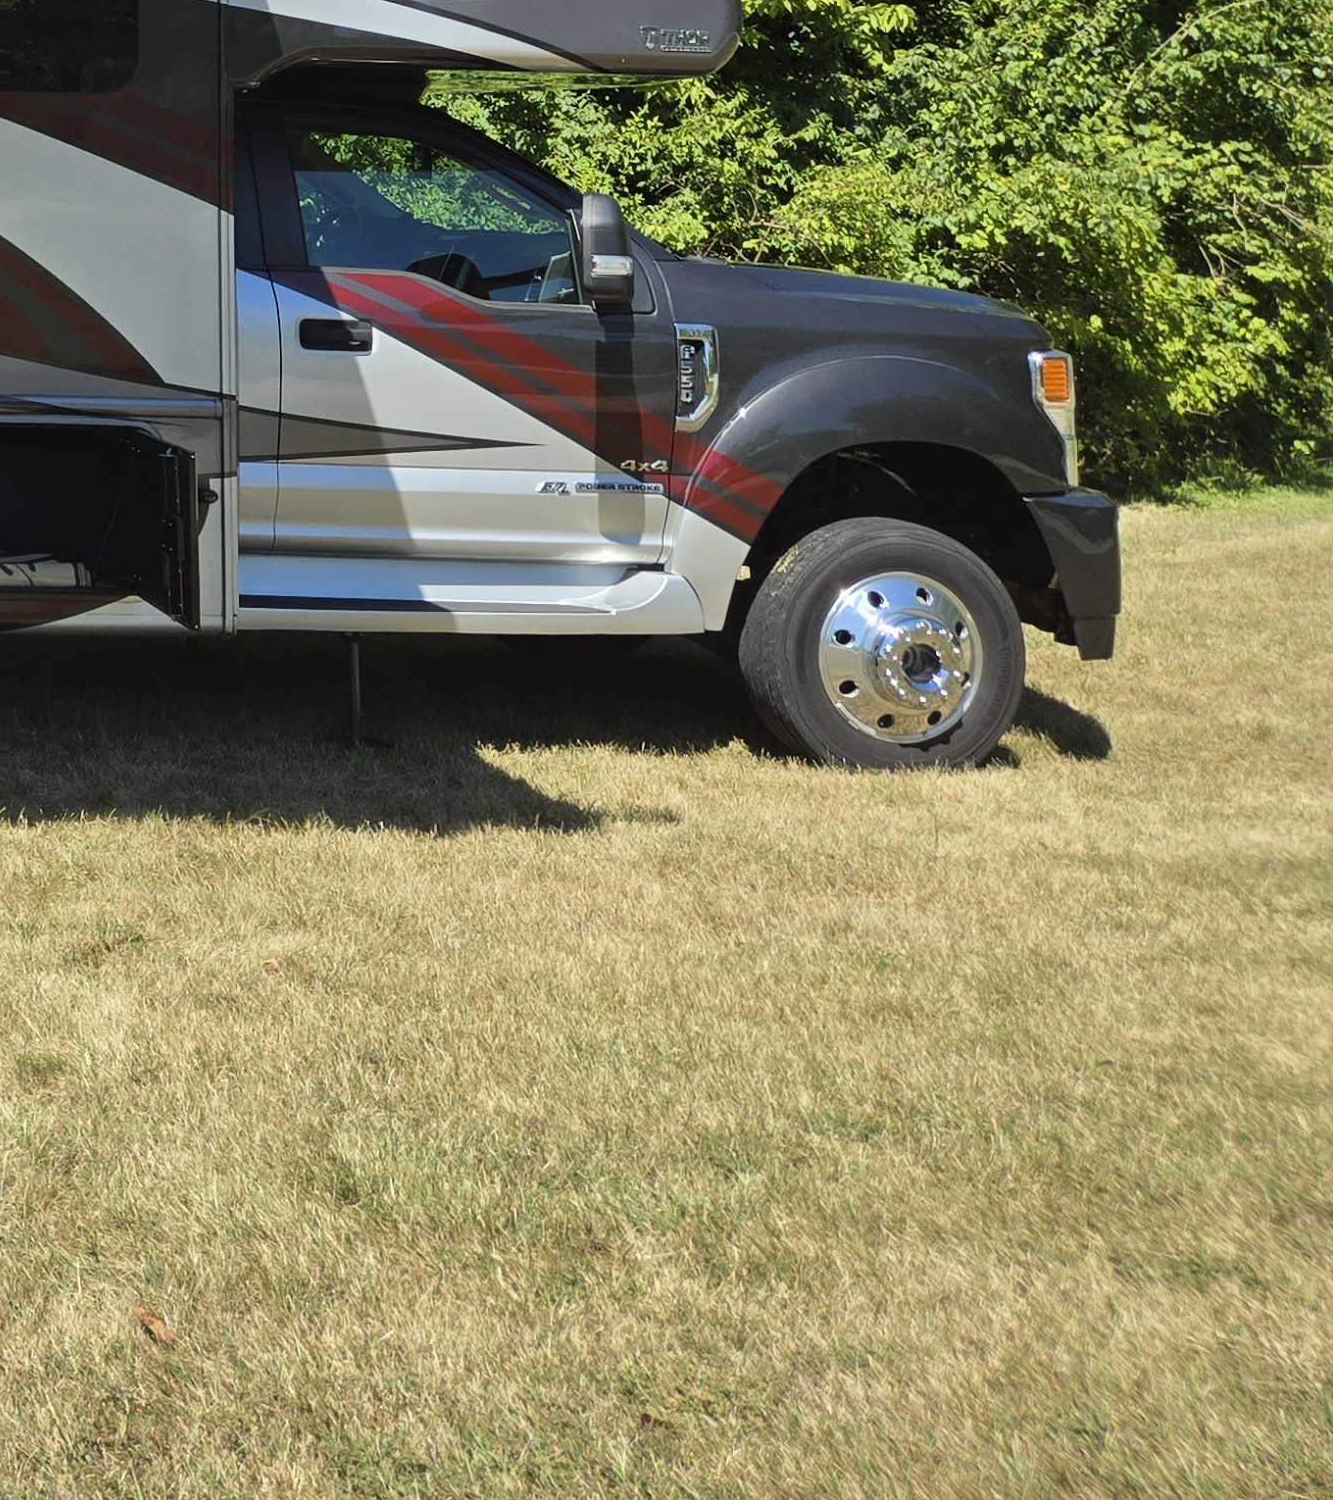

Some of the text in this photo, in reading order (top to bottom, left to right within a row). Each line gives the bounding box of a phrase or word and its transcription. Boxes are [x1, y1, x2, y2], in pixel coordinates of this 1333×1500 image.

[660, 28, 711, 46] THOR
[620, 459, 669, 472] 4x4
[578, 483, 616, 491] POWER
[618, 483, 661, 492] STROKE
